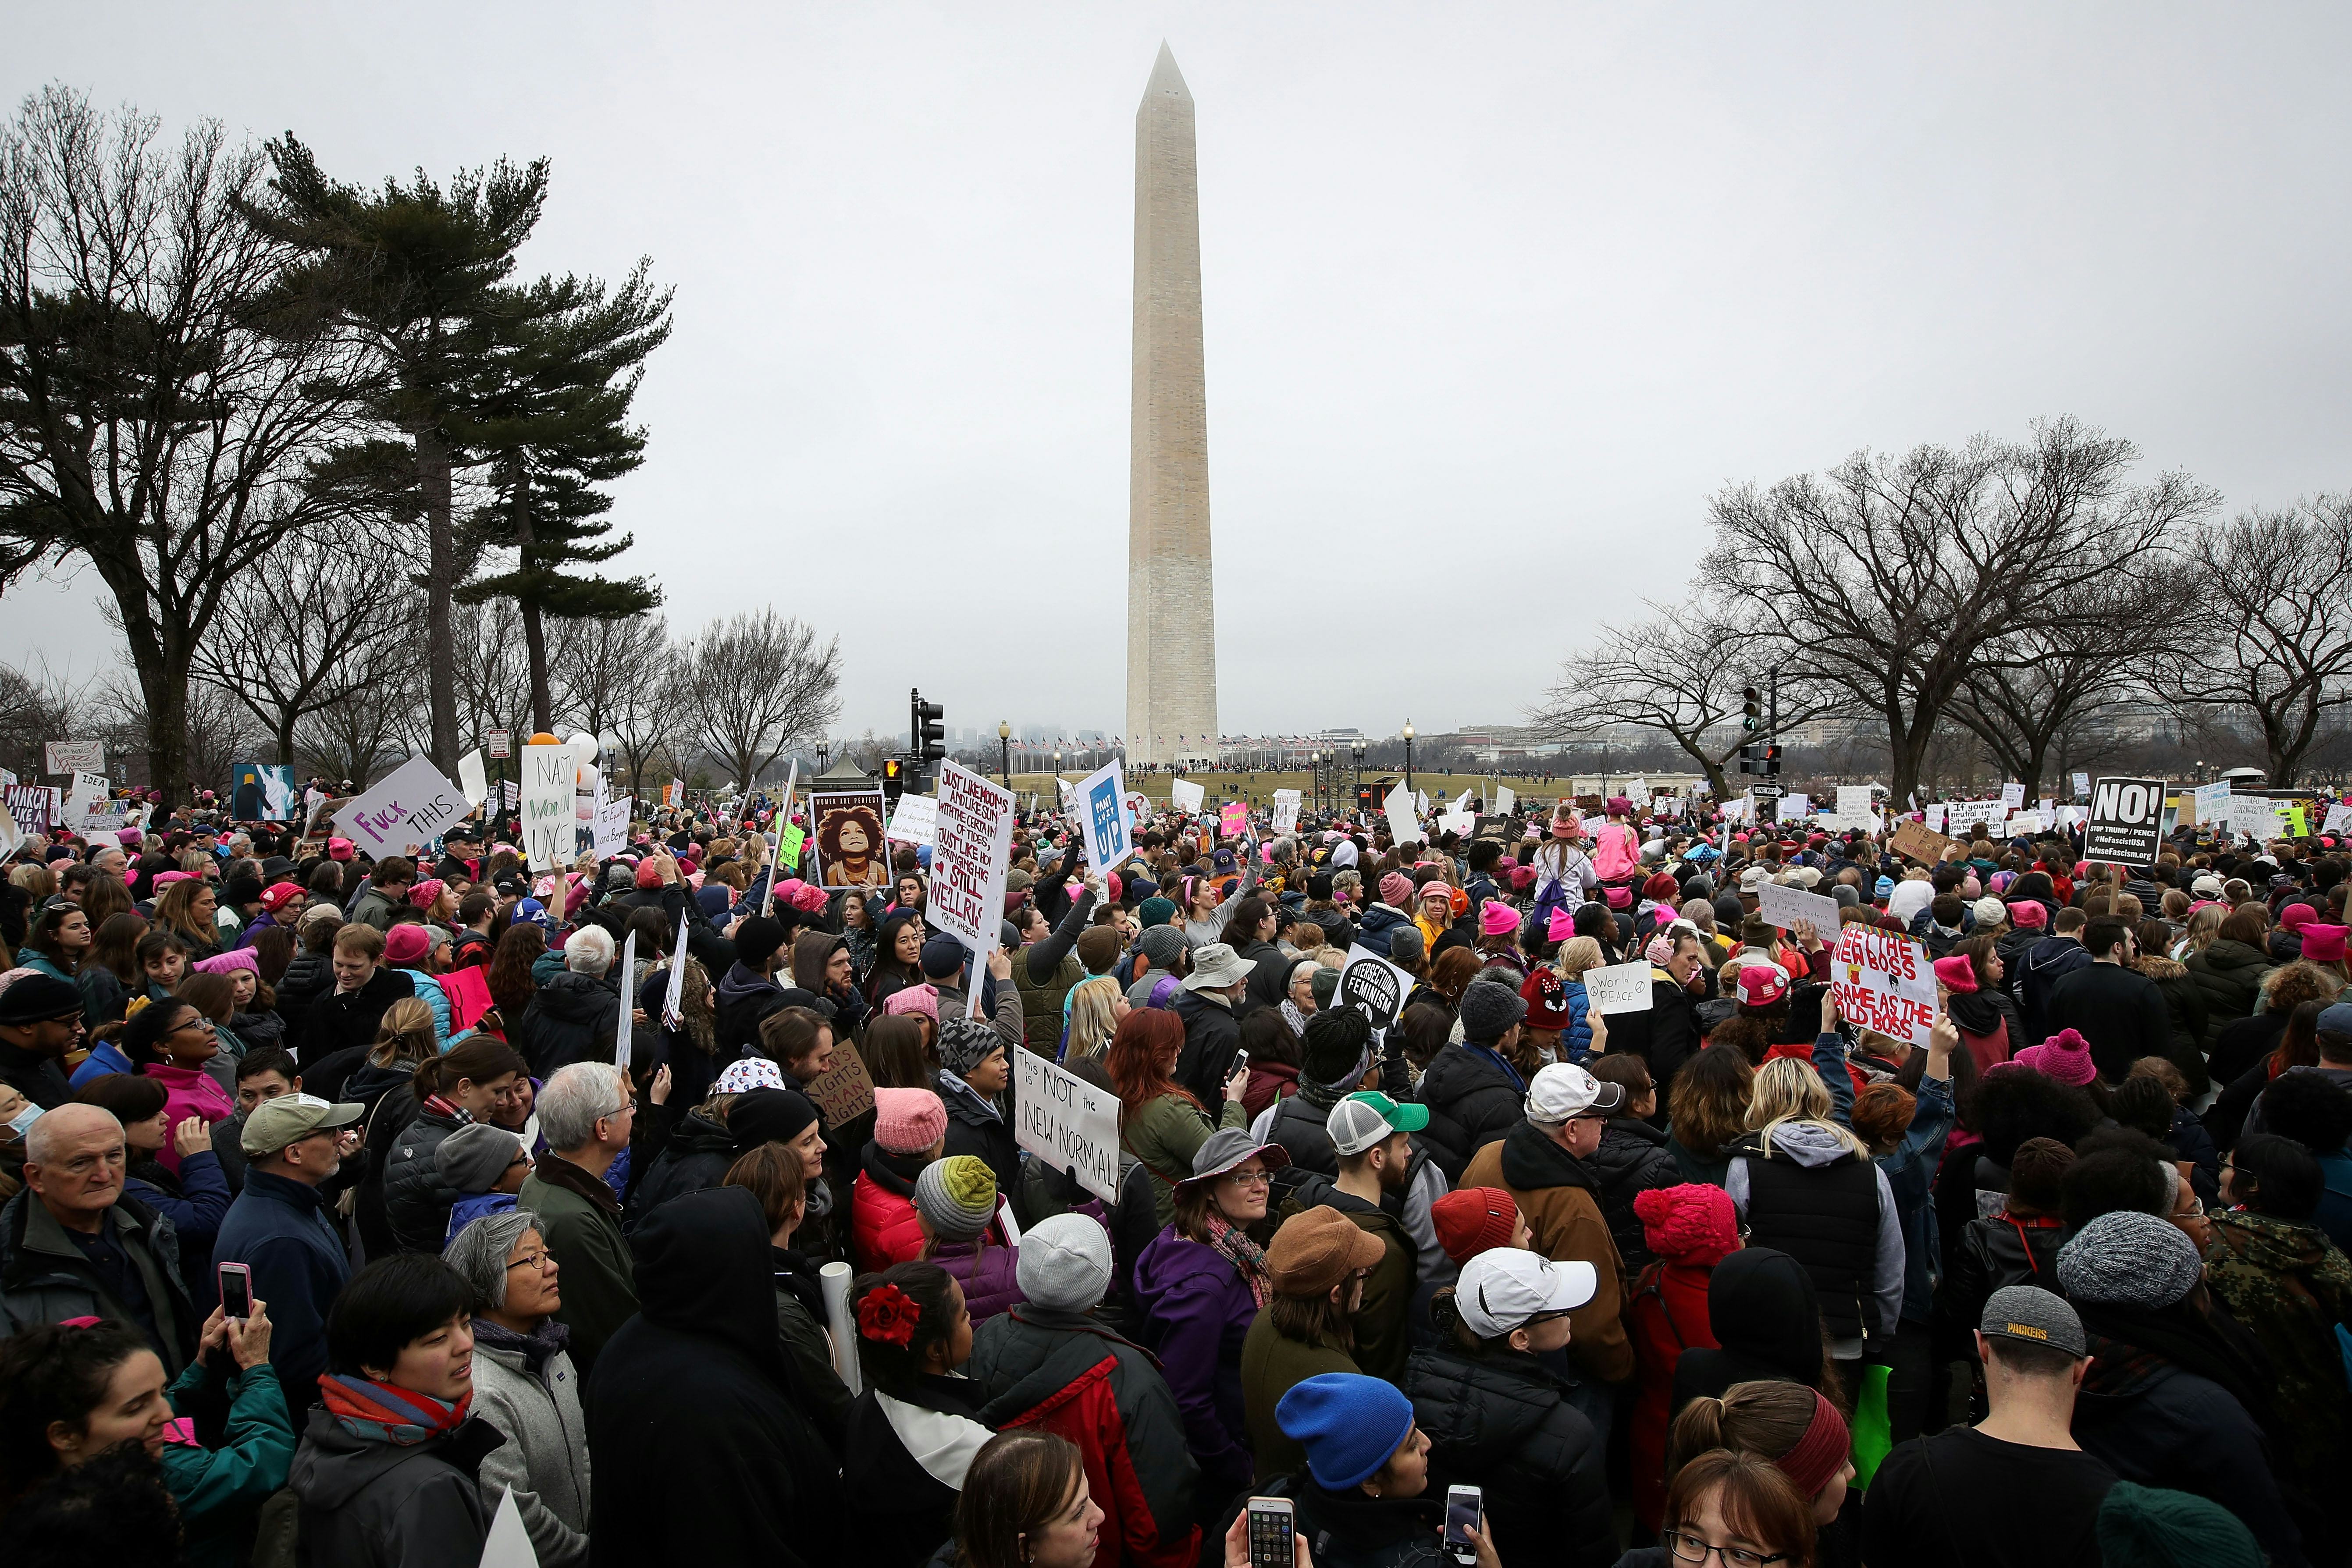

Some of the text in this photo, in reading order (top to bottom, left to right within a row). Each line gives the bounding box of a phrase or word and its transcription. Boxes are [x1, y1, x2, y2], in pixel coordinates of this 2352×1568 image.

[83, 759, 101, 767] POWER
[537, 754, 575, 787] NASTY
[942, 768, 1008, 813] JUST LIKE MOONS
[2208, 790, 2229, 800] CHANGING
[2210, 782, 2230, 792] CLIMATE
[7, 786, 48, 810] MARCH
[529, 793, 571, 820] WOMEN
[901, 797, 911, 806] Our
[922, 800, 935, 815] begin
[950, 790, 982, 816] AND LIKE
[1095, 794, 1112, 814] PANT
[2093, 784, 2160, 825] NO!
[2232, 795, 2259, 804] I AM
[9, 806, 33, 822] LIKE
[34, 810, 43, 823] A
[88, 800, 128, 815] WOMENS
[406, 794, 460, 834] THIS.
[897, 808, 906, 818] the
[907, 812, 916, 823] day
[1098, 807, 1114, 825] SUIT
[1223, 807, 1246, 825] Empathy
[2195, 804, 2210, 814] WHY
[2234, 804, 2265, 815] ANGRY
[83, 814, 125, 825] RIGHTS
[353, 800, 407, 844] FUCK
[601, 810, 608, 824] To
[1585, 817, 1603, 828] GIRLS
[612, 823, 629, 844] Beyond
[890, 823, 901, 832] silent
[1908, 823, 1930, 838] TITS
[938, 827, 978, 861] JUST LIKE
[957, 823, 990, 851] OF TIDES,
[2095, 835, 2145, 847] #NoFascistUSA
[1894, 838, 1924, 855] WOMENS
[1918, 840, 1939, 853] FOR
[2088, 846, 2152, 861] RefuseFascism.org
[938, 845, 975, 875] SPRINGING
[950, 864, 983, 900] STILL
[1770, 887, 1800, 898] believe
[1821, 900, 1833, 908] the
[1777, 896, 1802, 907] Power
[1804, 910, 1829, 921] Sisters
[942, 911, 979, 939] MAYA ANGELOU
[1838, 928, 1914, 961] MEET THE
[1833, 942, 1916, 981] NEW BOSS
[1352, 963, 1397, 1001] INTERSECTIONAL
[1594, 971, 1629, 987] World
[1348, 977, 1392, 1014] FEMINISM
[1600, 990, 1633, 1005] PEACE
[1833, 981, 1932, 1028] SAME AS THE
[1835, 999, 1913, 1040] OLD BOSS
[1017, 1051, 1038, 1075] This
[1025, 1066, 1096, 1112] is NOT the
[1025, 1099, 1115, 1189] NEW NORMAL
[2007, 1322, 2048, 1340] PACKERS
